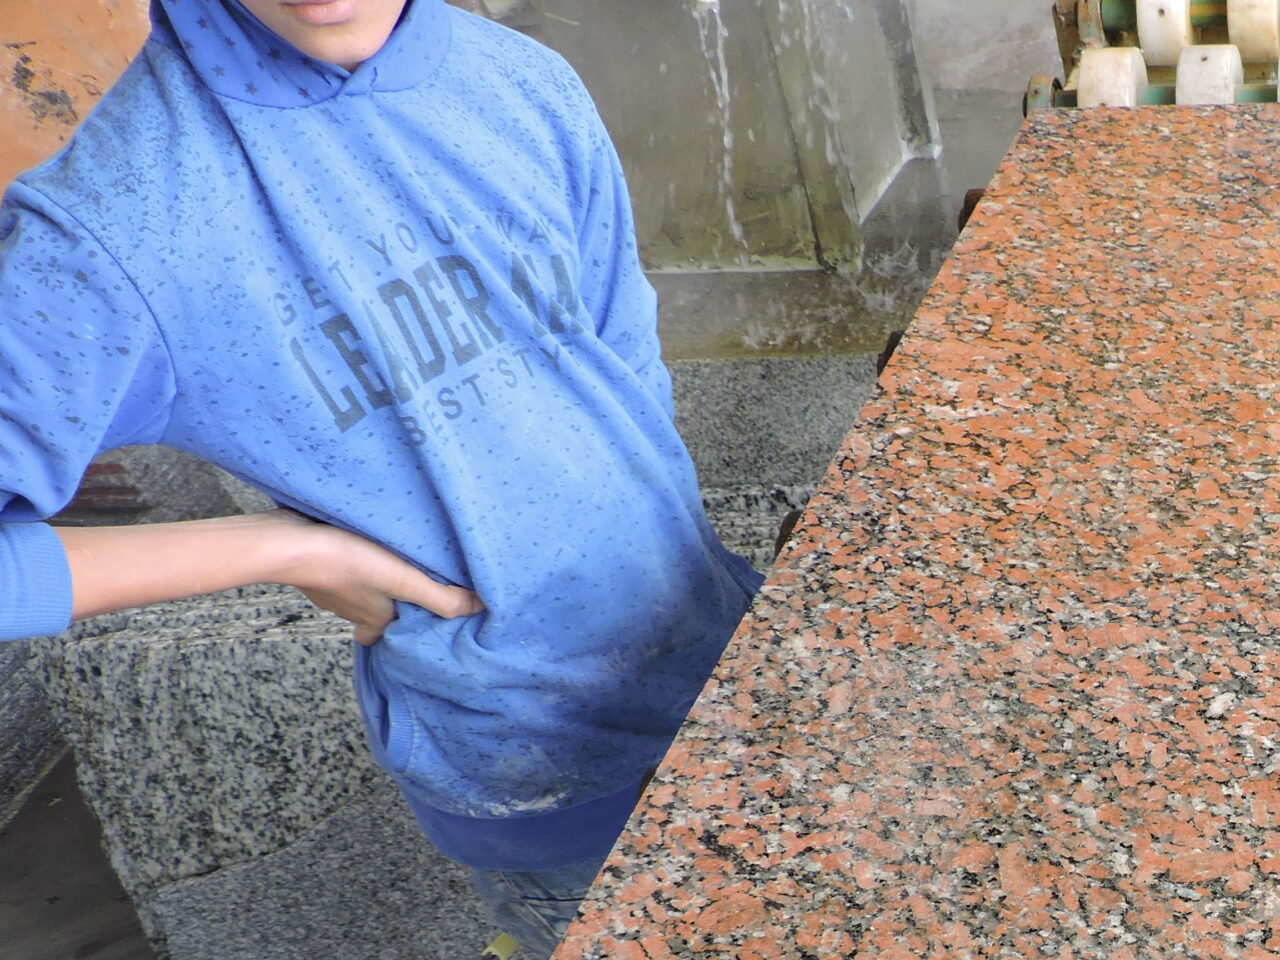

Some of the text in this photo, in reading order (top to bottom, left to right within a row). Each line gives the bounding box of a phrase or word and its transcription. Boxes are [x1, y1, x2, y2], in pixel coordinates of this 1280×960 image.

[273, 259, 353, 327] GET
[366, 214, 460, 267] YOU
[289, 254, 506, 434] LEADER
[399, 343, 562, 447] BEST STY
